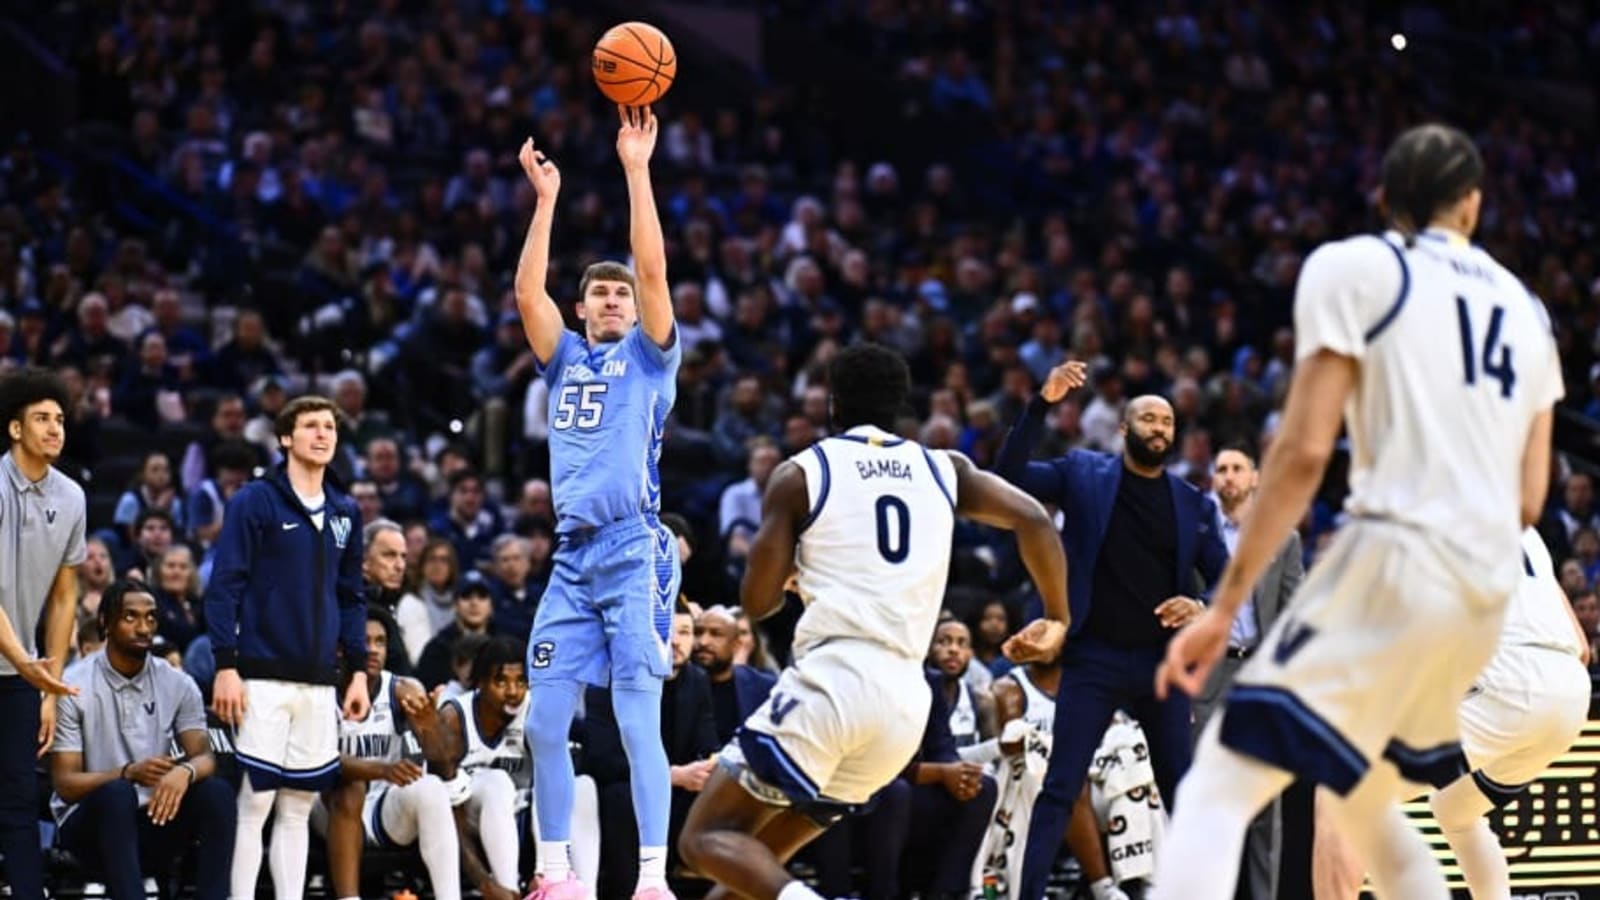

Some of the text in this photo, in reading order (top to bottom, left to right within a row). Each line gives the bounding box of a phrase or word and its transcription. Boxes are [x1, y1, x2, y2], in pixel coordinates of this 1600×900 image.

[1456, 294, 1516, 398] 14
[553, 382, 608, 431] 55
[856, 459, 912, 481] BAMBA
[875, 495, 910, 565] 0
